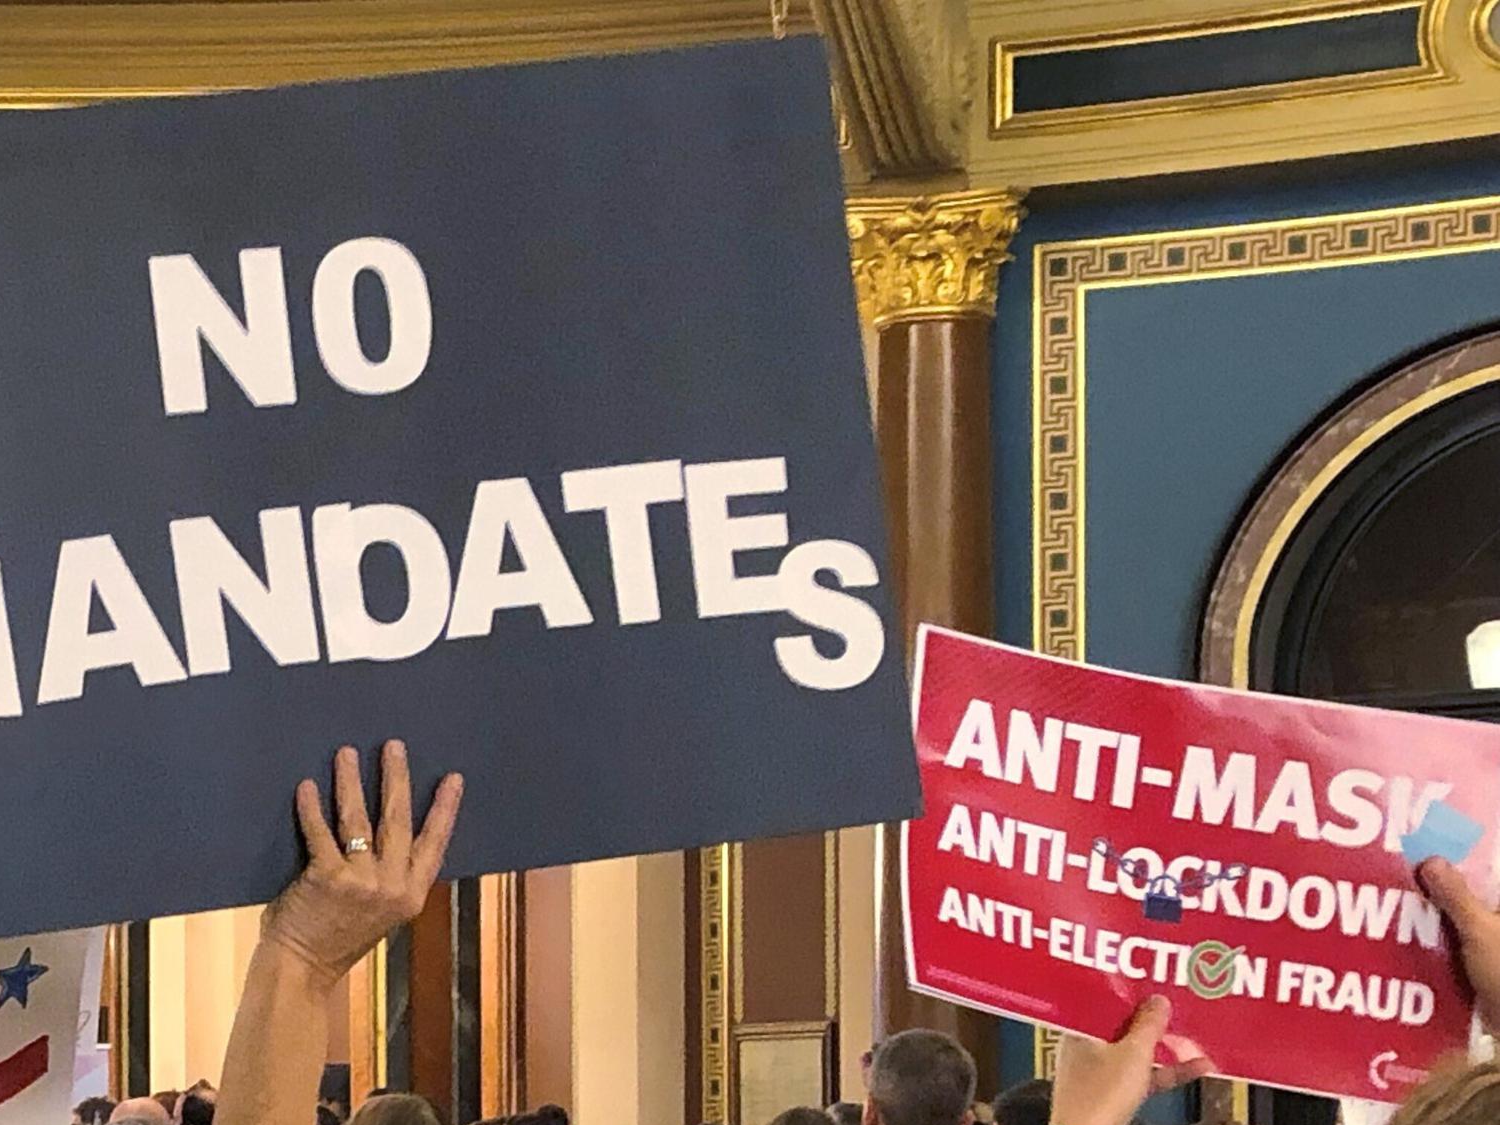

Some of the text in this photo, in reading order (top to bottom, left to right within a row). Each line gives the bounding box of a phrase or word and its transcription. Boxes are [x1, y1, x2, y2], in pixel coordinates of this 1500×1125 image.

[148, 236, 432, 415] NO
[944, 699, 1453, 852] ANTI-MASK
[937, 803, 1441, 948] ANTI-LOCKDOWN
[1277, 961, 1435, 1026] FRAUD
